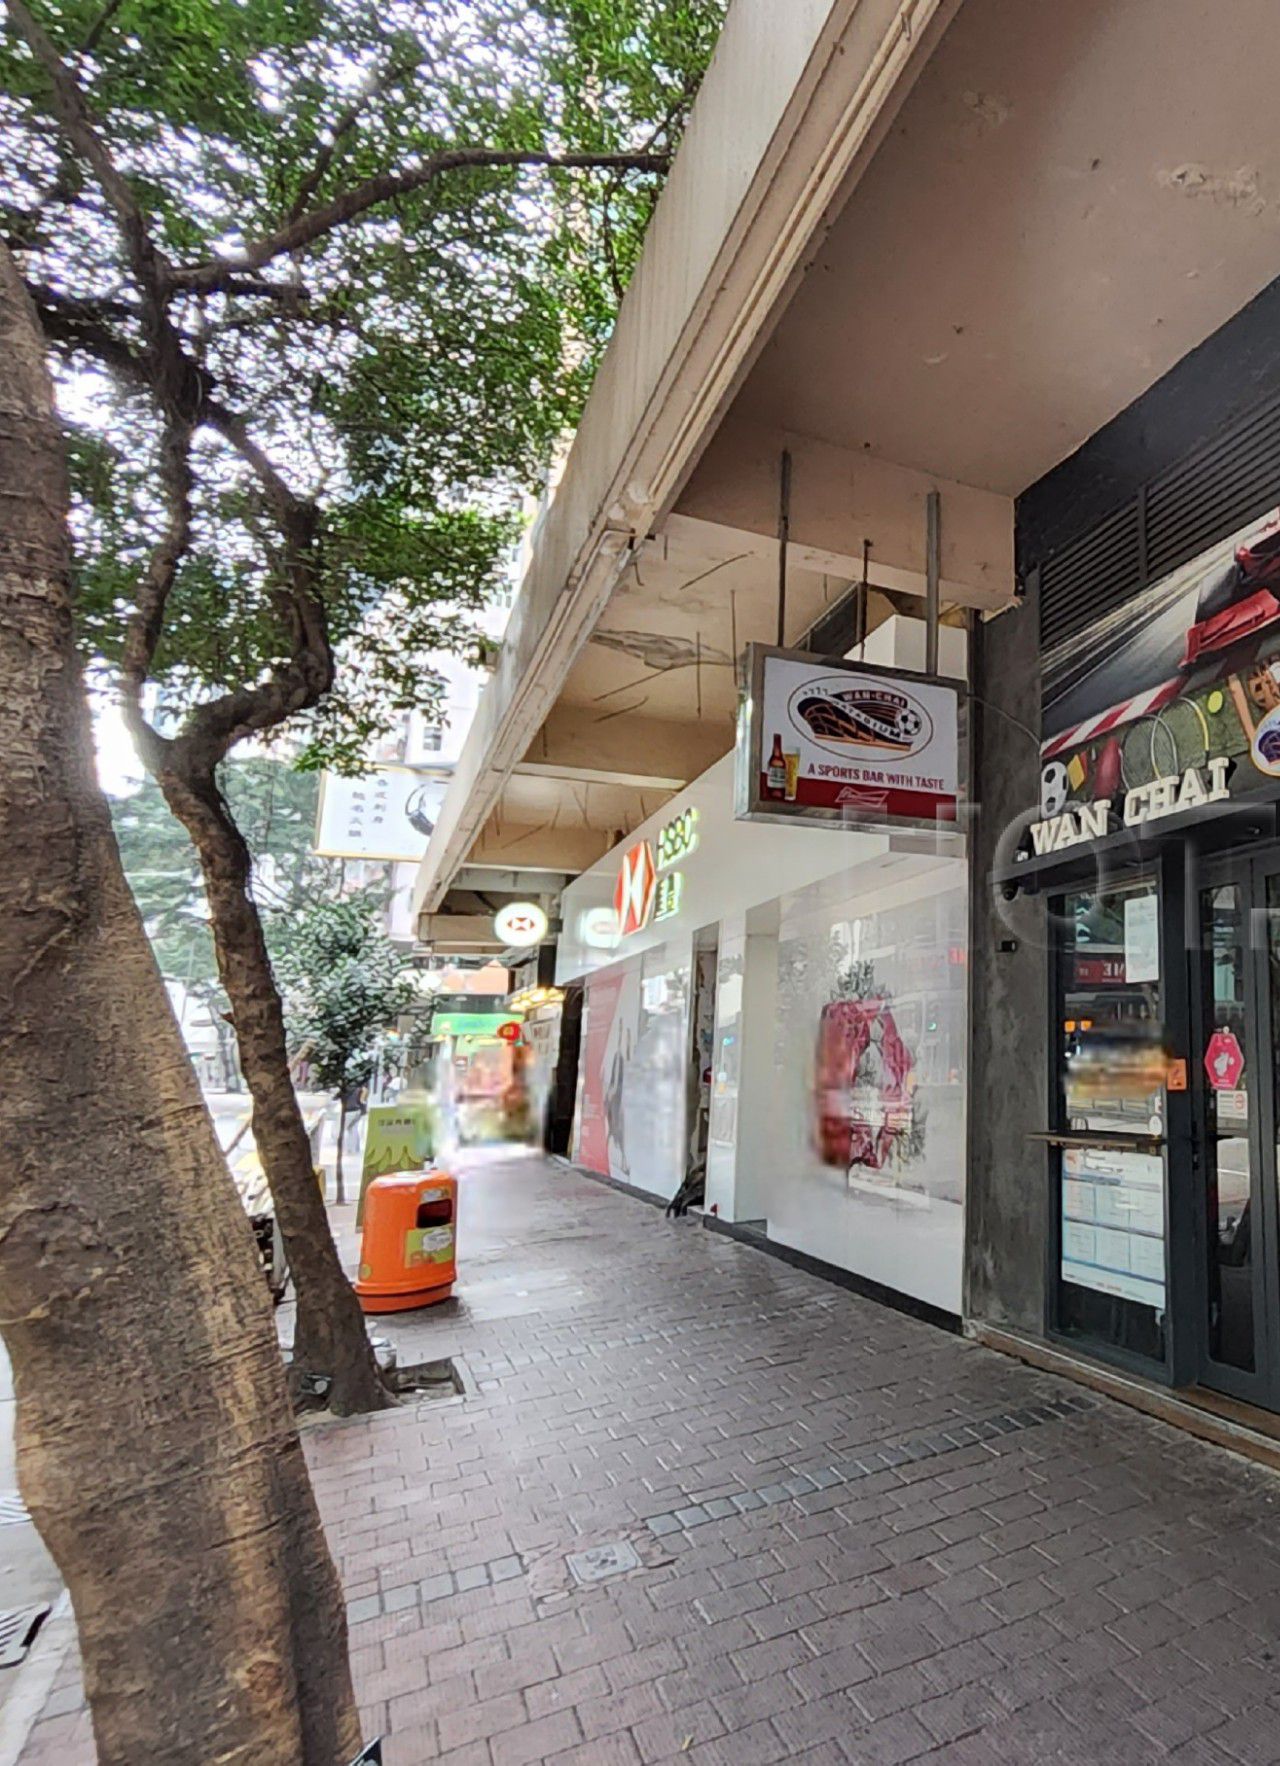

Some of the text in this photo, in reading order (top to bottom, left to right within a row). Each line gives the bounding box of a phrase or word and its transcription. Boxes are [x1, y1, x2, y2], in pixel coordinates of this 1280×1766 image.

[807, 763, 945, 790] A SPORTS BAR WITH TASTE
[1030, 757, 1231, 856] WAN CHAI
